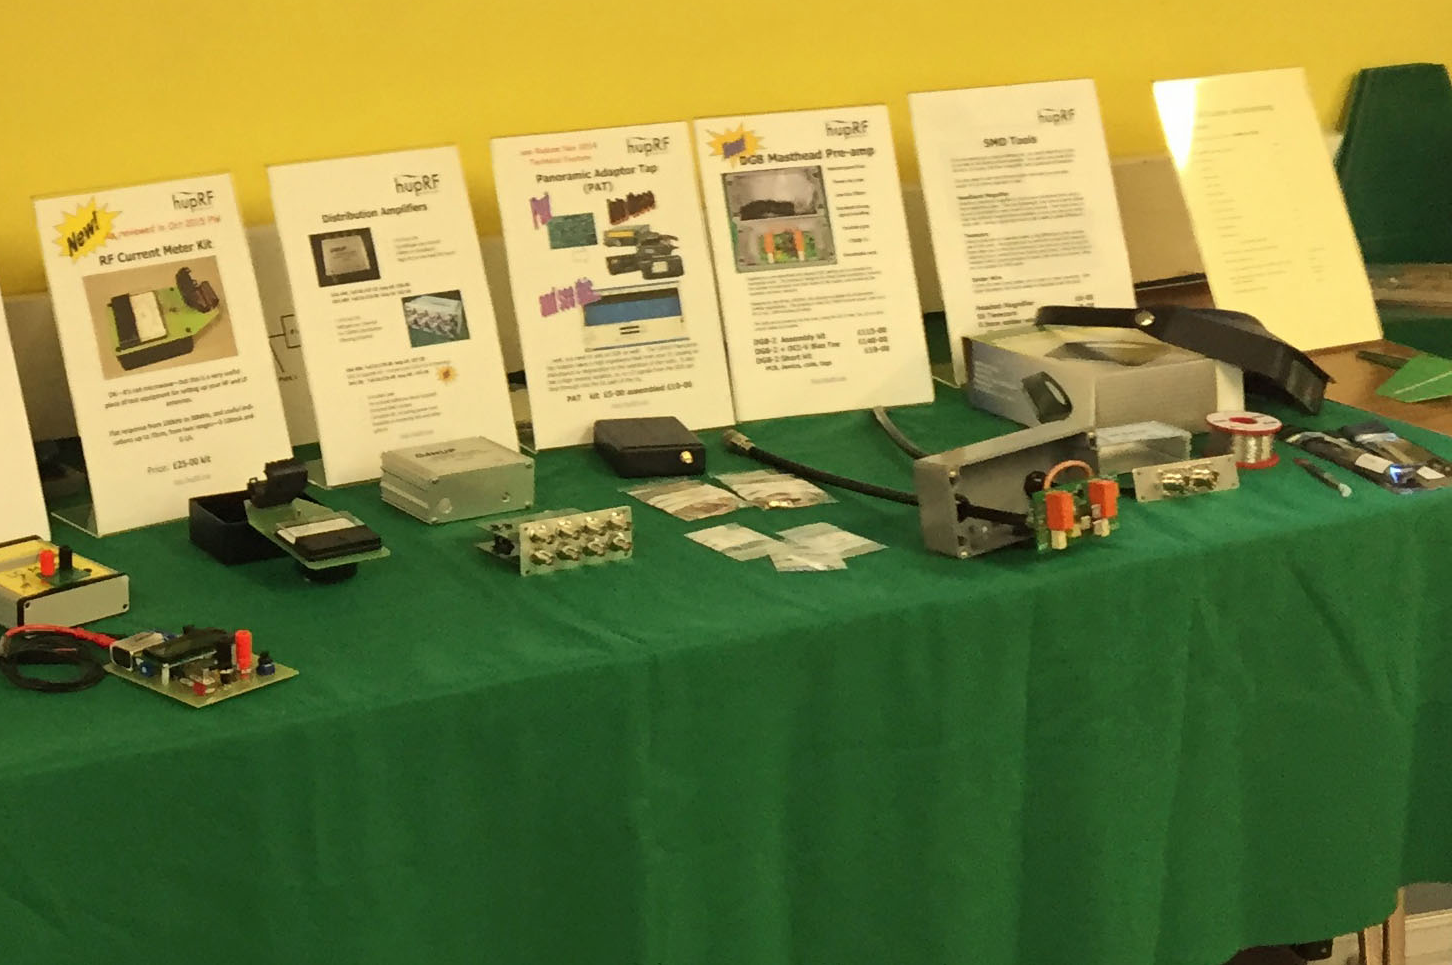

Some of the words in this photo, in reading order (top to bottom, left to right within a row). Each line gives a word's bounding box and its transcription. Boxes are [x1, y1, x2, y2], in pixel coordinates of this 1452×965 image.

[826, 119, 868, 140] hupRF
[626, 136, 670, 157] hupRF
[983, 137, 1007, 148] SMD
[1010, 135, 1038, 145] Tools
[767, 149, 822, 163] Masthead
[826, 146, 875, 160] Pre-amp
[536, 169, 591, 183] Panoramic
[594, 165, 635, 179] Adaptor
[639, 163, 658, 176] Tap
[394, 173, 440, 196] hupRF
[583, 181, 614, 195] (PAT)
[172, 191, 214, 212] hupRF
[322, 206, 378, 223] Distribution
[381, 203, 428, 217] Amplifiers
[66, 210, 100, 257] New!
[99, 254, 113, 266] RF
[117, 247, 161, 262] Current
[163, 242, 193, 257] Meter
[196, 238, 212, 250] Kit
